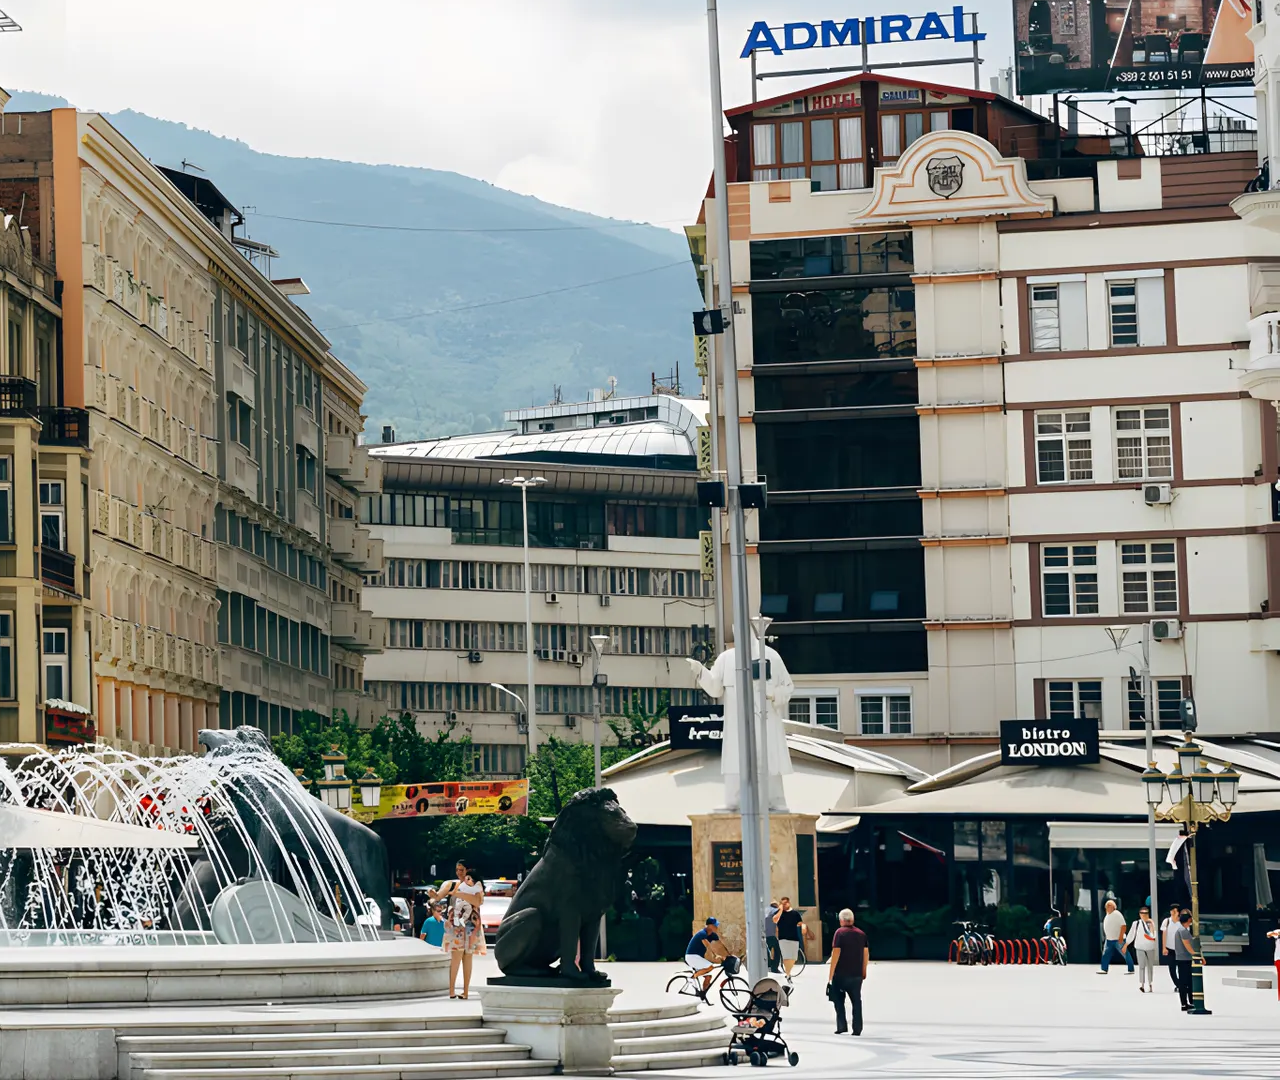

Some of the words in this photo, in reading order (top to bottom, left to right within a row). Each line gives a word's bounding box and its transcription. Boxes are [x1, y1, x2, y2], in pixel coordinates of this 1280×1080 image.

[739, 5, 987, 59] ADMIRAL
[811, 92, 861, 111] HOTEL
[1022, 726, 1071, 740] bistro
[1007, 741, 1088, 758] LONDON
